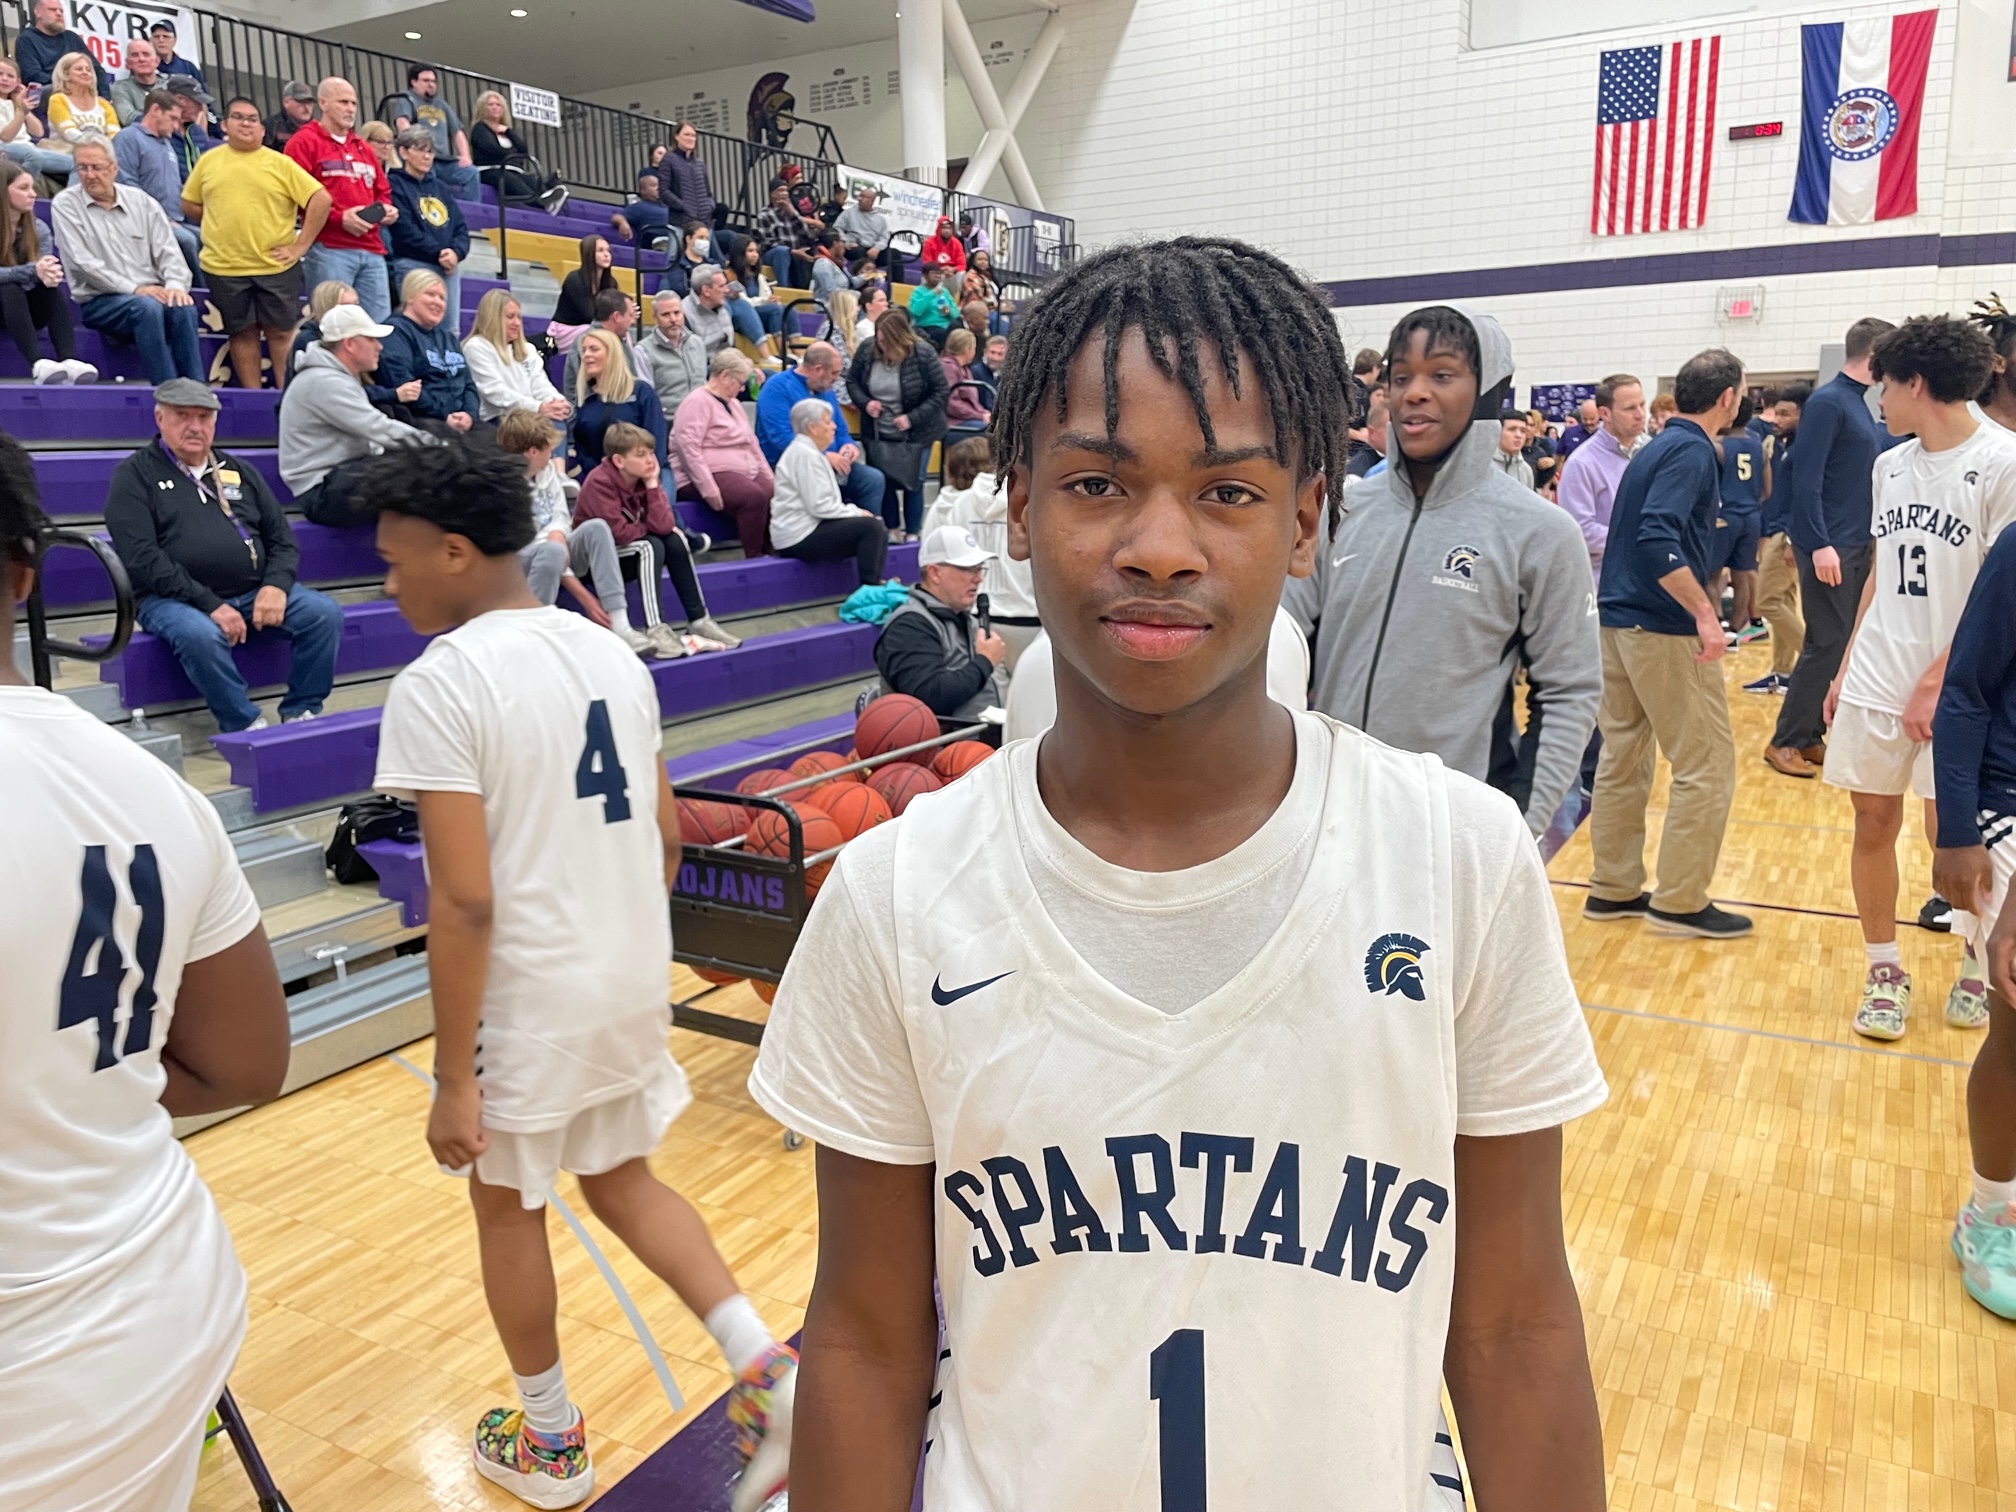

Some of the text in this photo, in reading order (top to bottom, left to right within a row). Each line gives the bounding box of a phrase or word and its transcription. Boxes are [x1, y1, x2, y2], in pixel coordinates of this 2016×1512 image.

[79, 34, 122, 69] 05
[514, 87, 556, 108] VISITOR
[514, 102, 558, 123] SEATING
[1736, 453, 1752, 481] 5
[1877, 504, 1972, 548] SPARTANS
[1897, 543, 1928, 597] 13
[576, 699, 631, 824] 4
[56, 843, 167, 1072] 41
[943, 1131, 1450, 1294] SPARTANS
[1149, 1329, 1206, 1512] 1
